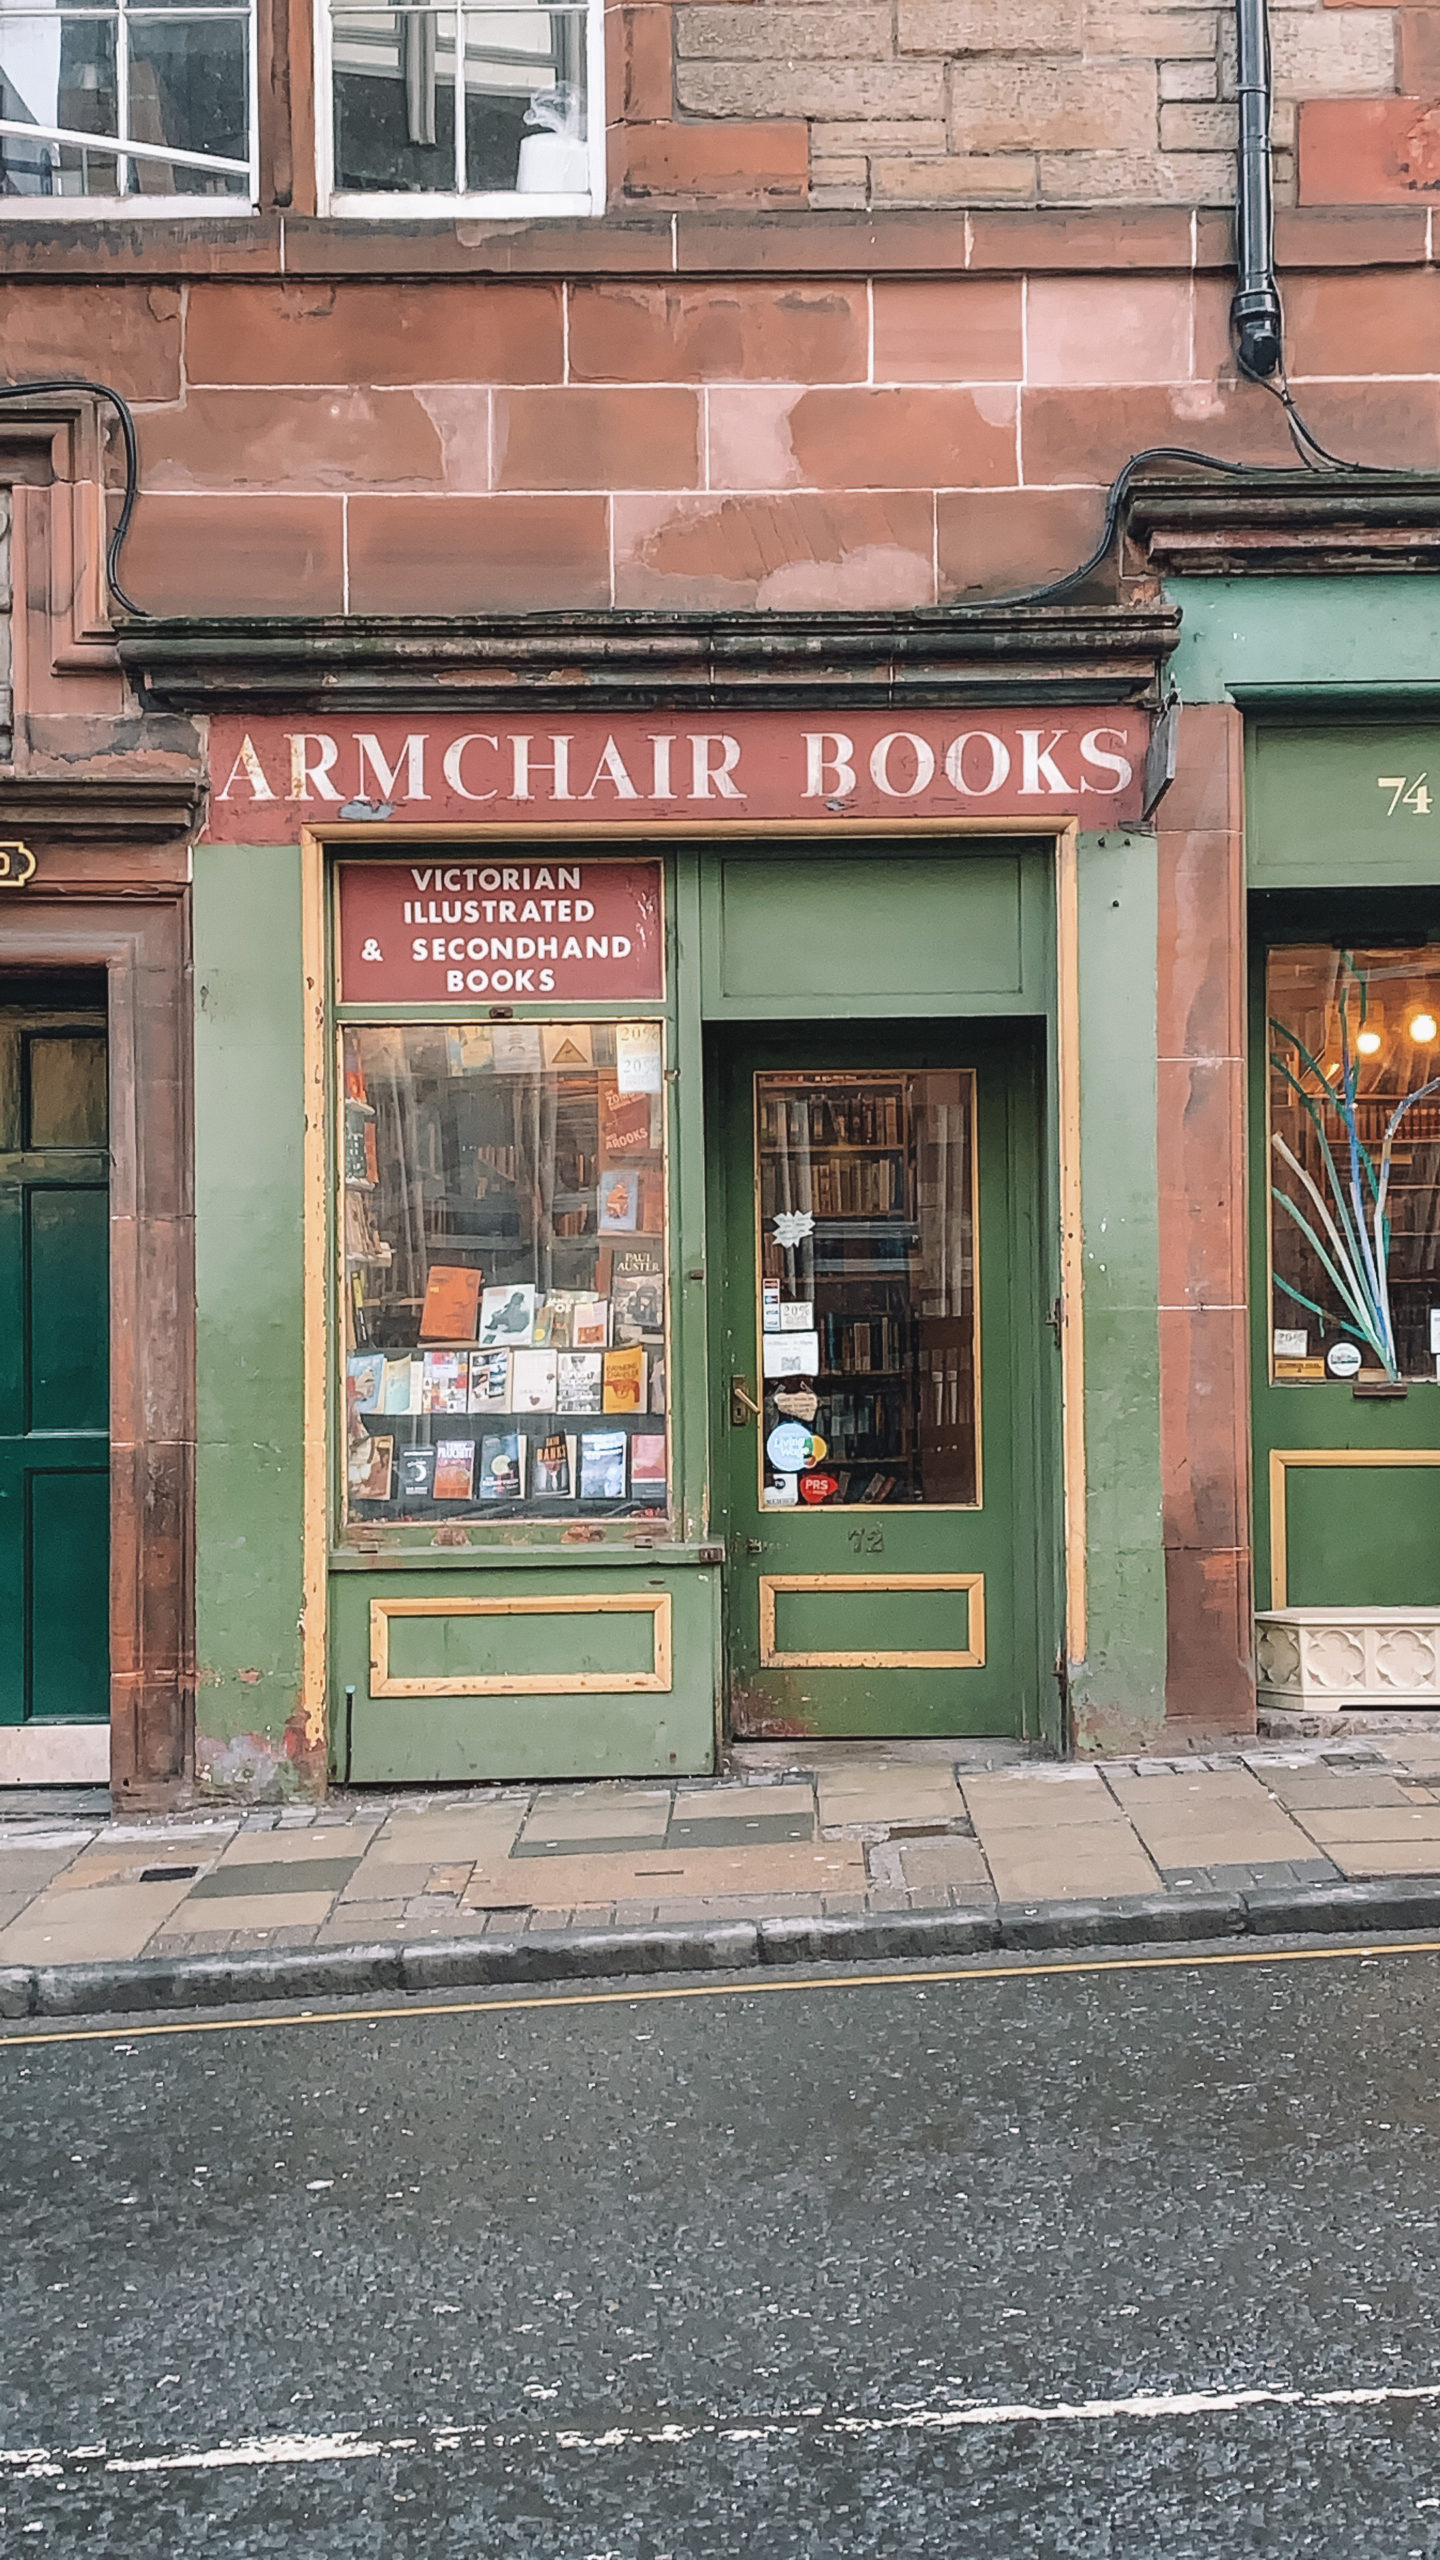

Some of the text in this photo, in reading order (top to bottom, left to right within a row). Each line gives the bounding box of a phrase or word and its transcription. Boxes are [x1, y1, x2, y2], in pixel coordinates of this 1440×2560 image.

[214, 727, 1133, 801] ARMCHAIR BOOKS
[1377, 771, 1433, 817] 74
[411, 867, 581, 892] VICTORIAN
[403, 899, 595, 924] ILLUSTRATED
[361, 935, 632, 962] & SECONDHAND
[446, 968, 556, 993] BOOKS
[805, 1479, 828, 1491] PRS
[848, 1528, 884, 1553] 72
